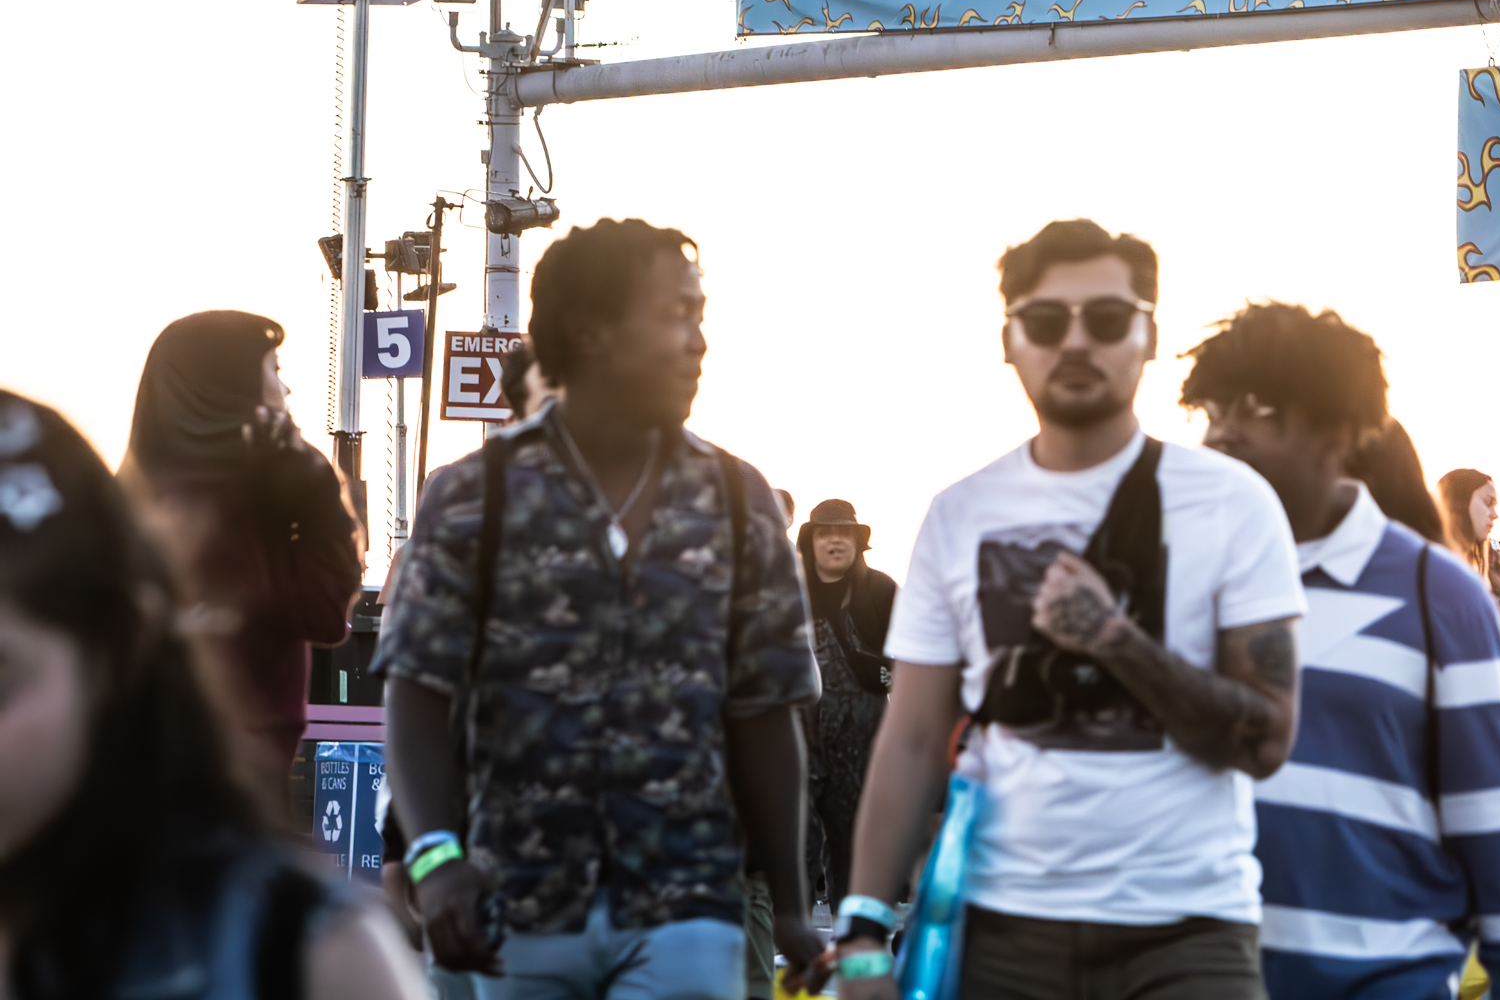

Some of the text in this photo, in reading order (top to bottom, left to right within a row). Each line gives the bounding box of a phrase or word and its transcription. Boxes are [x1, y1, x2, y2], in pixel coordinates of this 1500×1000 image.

[376, 316, 412, 369] 5
[320, 761, 350, 775] BOTTLES
[328, 777, 347, 790] CANS
